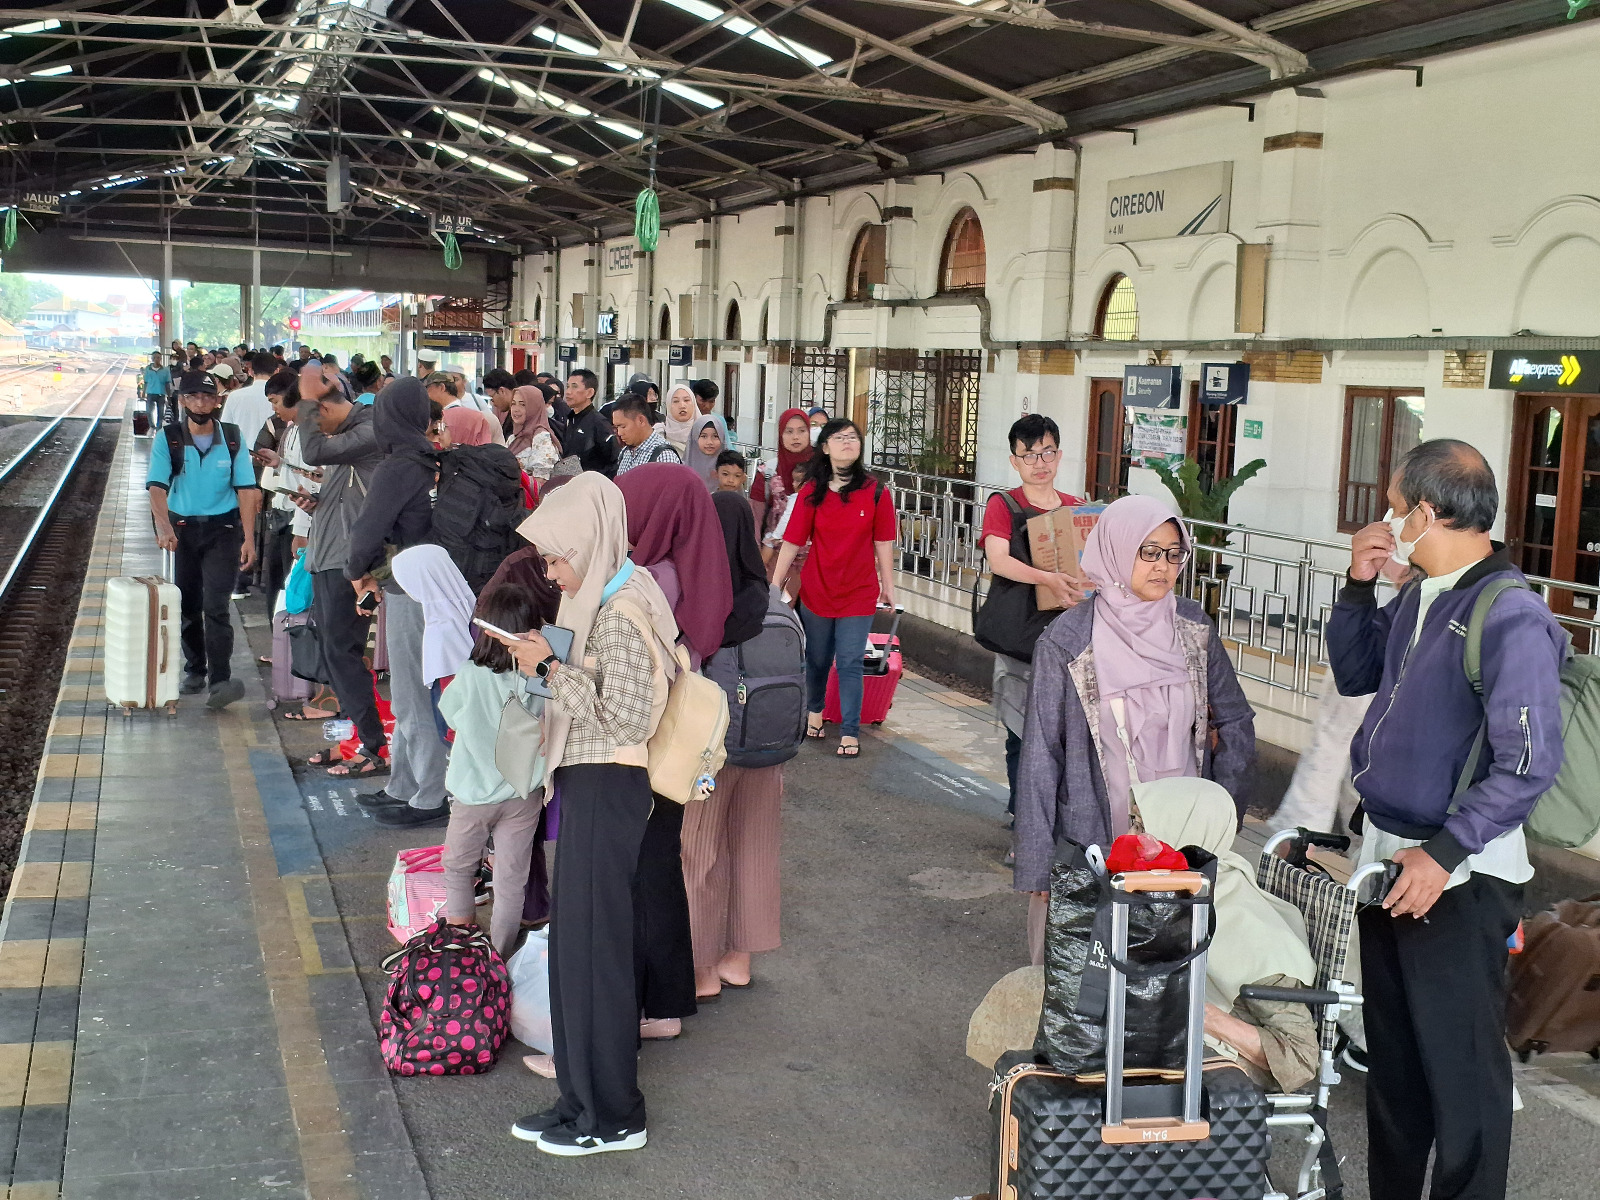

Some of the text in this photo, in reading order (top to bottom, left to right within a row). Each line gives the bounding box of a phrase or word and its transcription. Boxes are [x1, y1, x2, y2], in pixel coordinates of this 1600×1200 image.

[23, 193, 60, 205] JALUR
[1110, 189, 1165, 218] CIREBON
[30, 203, 52, 211] TRACK
[439, 214, 472, 226] JAUR
[294, 296, 300, 308] 3
[598, 314, 614, 335] KFC
[1138, 376, 1163, 386] Keamanan
